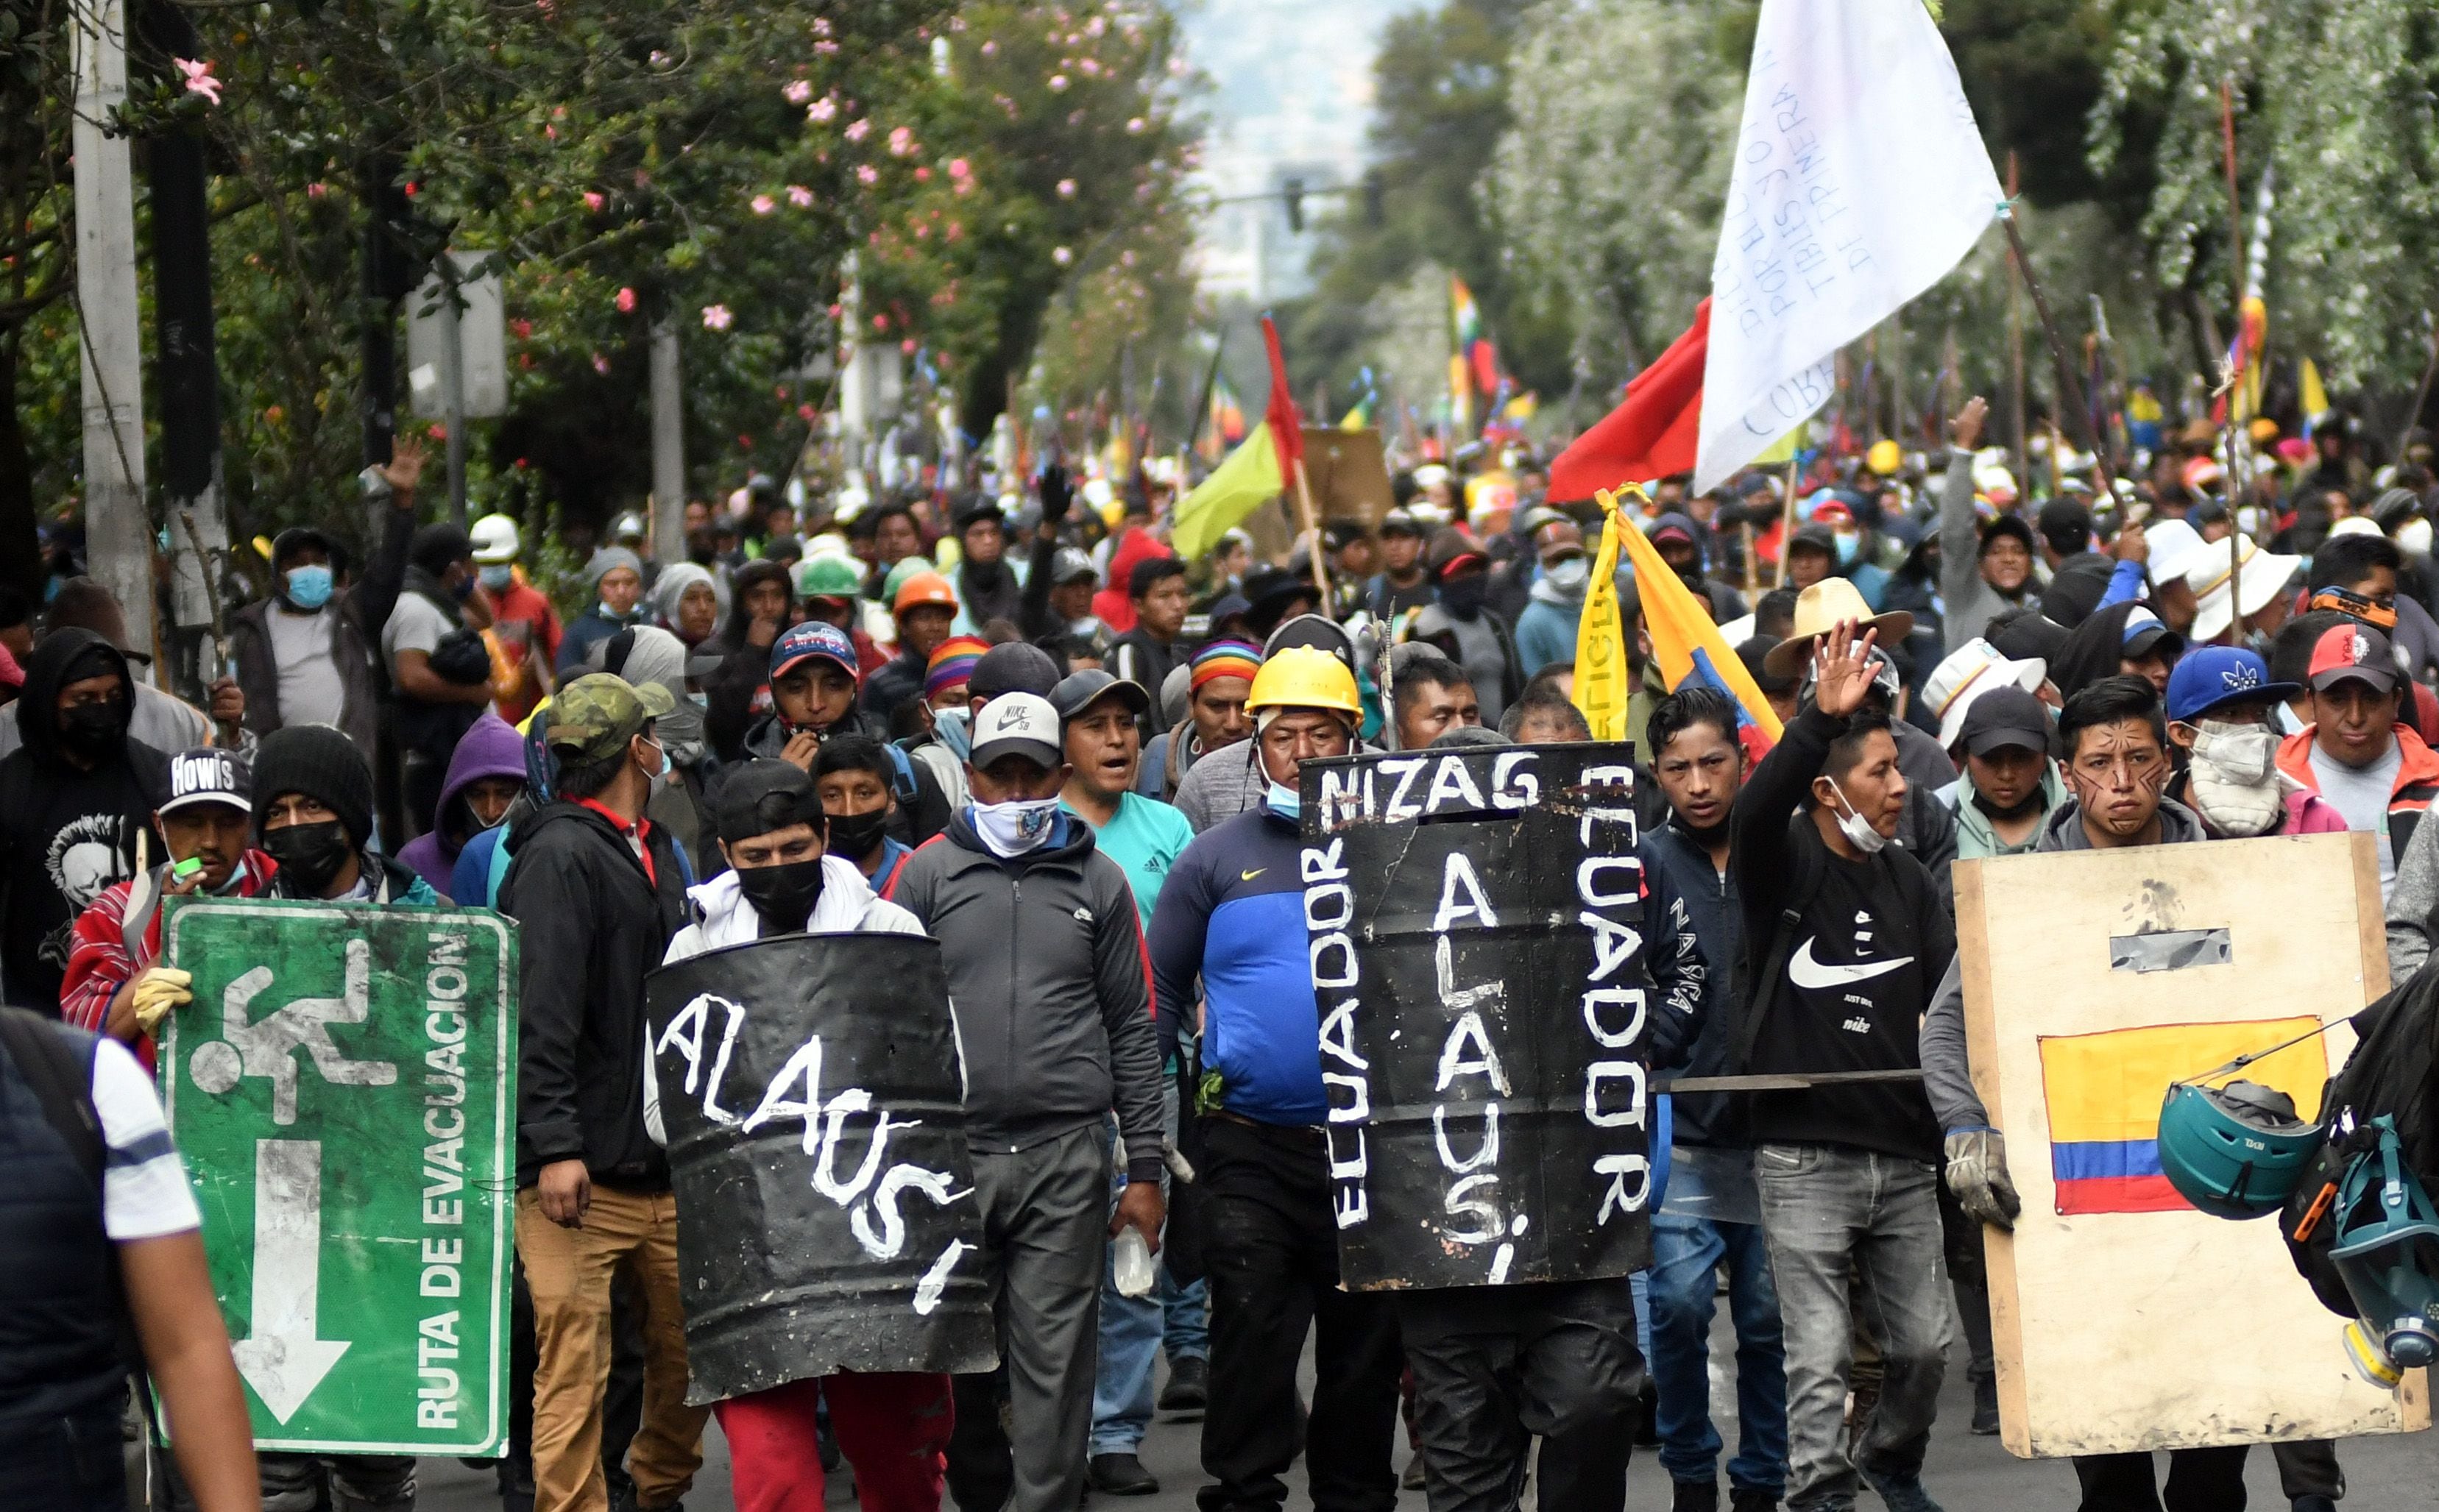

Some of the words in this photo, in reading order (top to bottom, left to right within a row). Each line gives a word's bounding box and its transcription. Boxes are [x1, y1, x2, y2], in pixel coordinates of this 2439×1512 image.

[1771, 82, 1849, 224] PRIMERA
[1752, 250, 1797, 317] POR
[1774, 199, 1835, 298] TIBLES
[1002, 705, 1028, 718] NIKE
[1018, 720, 1030, 731] SB
[1320, 751, 1540, 834] NIZAG
[1300, 837, 1369, 1229] ECUADOR
[1576, 764, 1651, 1227] ECUADOR
[1842, 1016, 1871, 1034] nike
[422, 932, 469, 1224] EVACUACION
[420, 1238, 462, 1298] DE
[417, 1310, 461, 1429] RUTA
